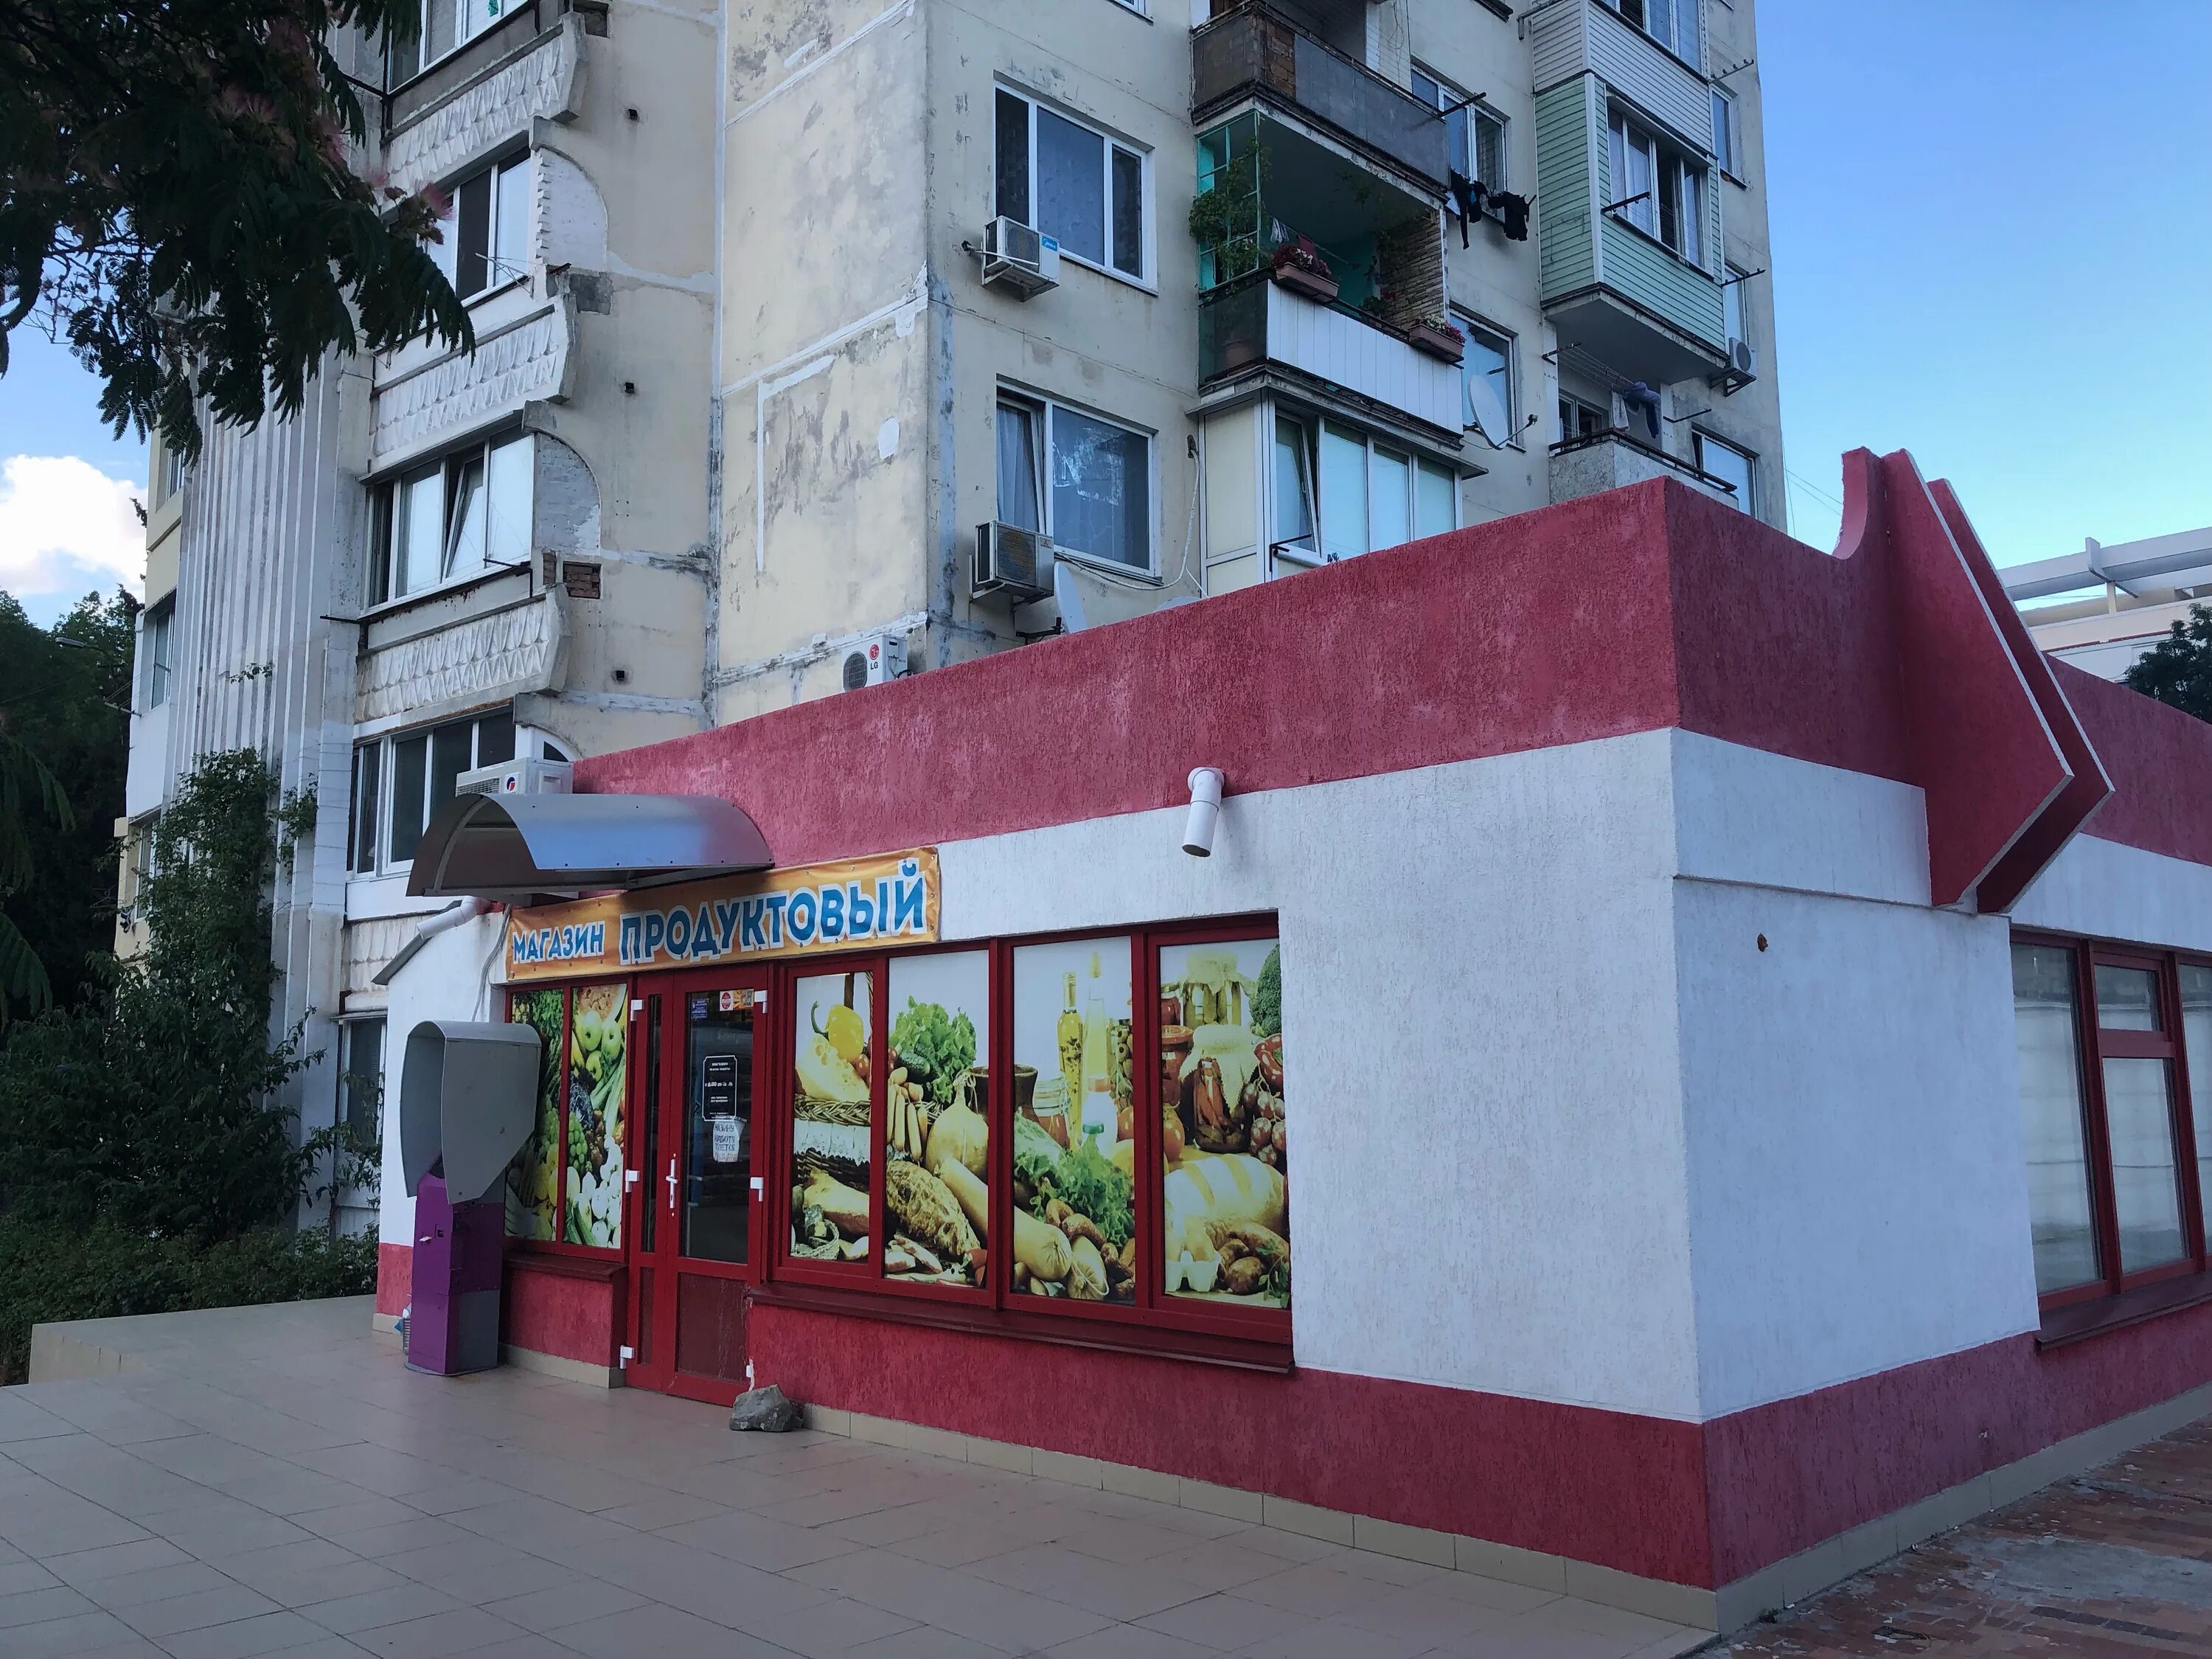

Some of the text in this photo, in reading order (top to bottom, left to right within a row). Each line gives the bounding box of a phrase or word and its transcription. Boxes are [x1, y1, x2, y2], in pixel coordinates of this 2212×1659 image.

[871, 661, 878, 670] LG
[512, 859, 925, 963] МАГАЗИН ПРОДУКТОВЫЙ
